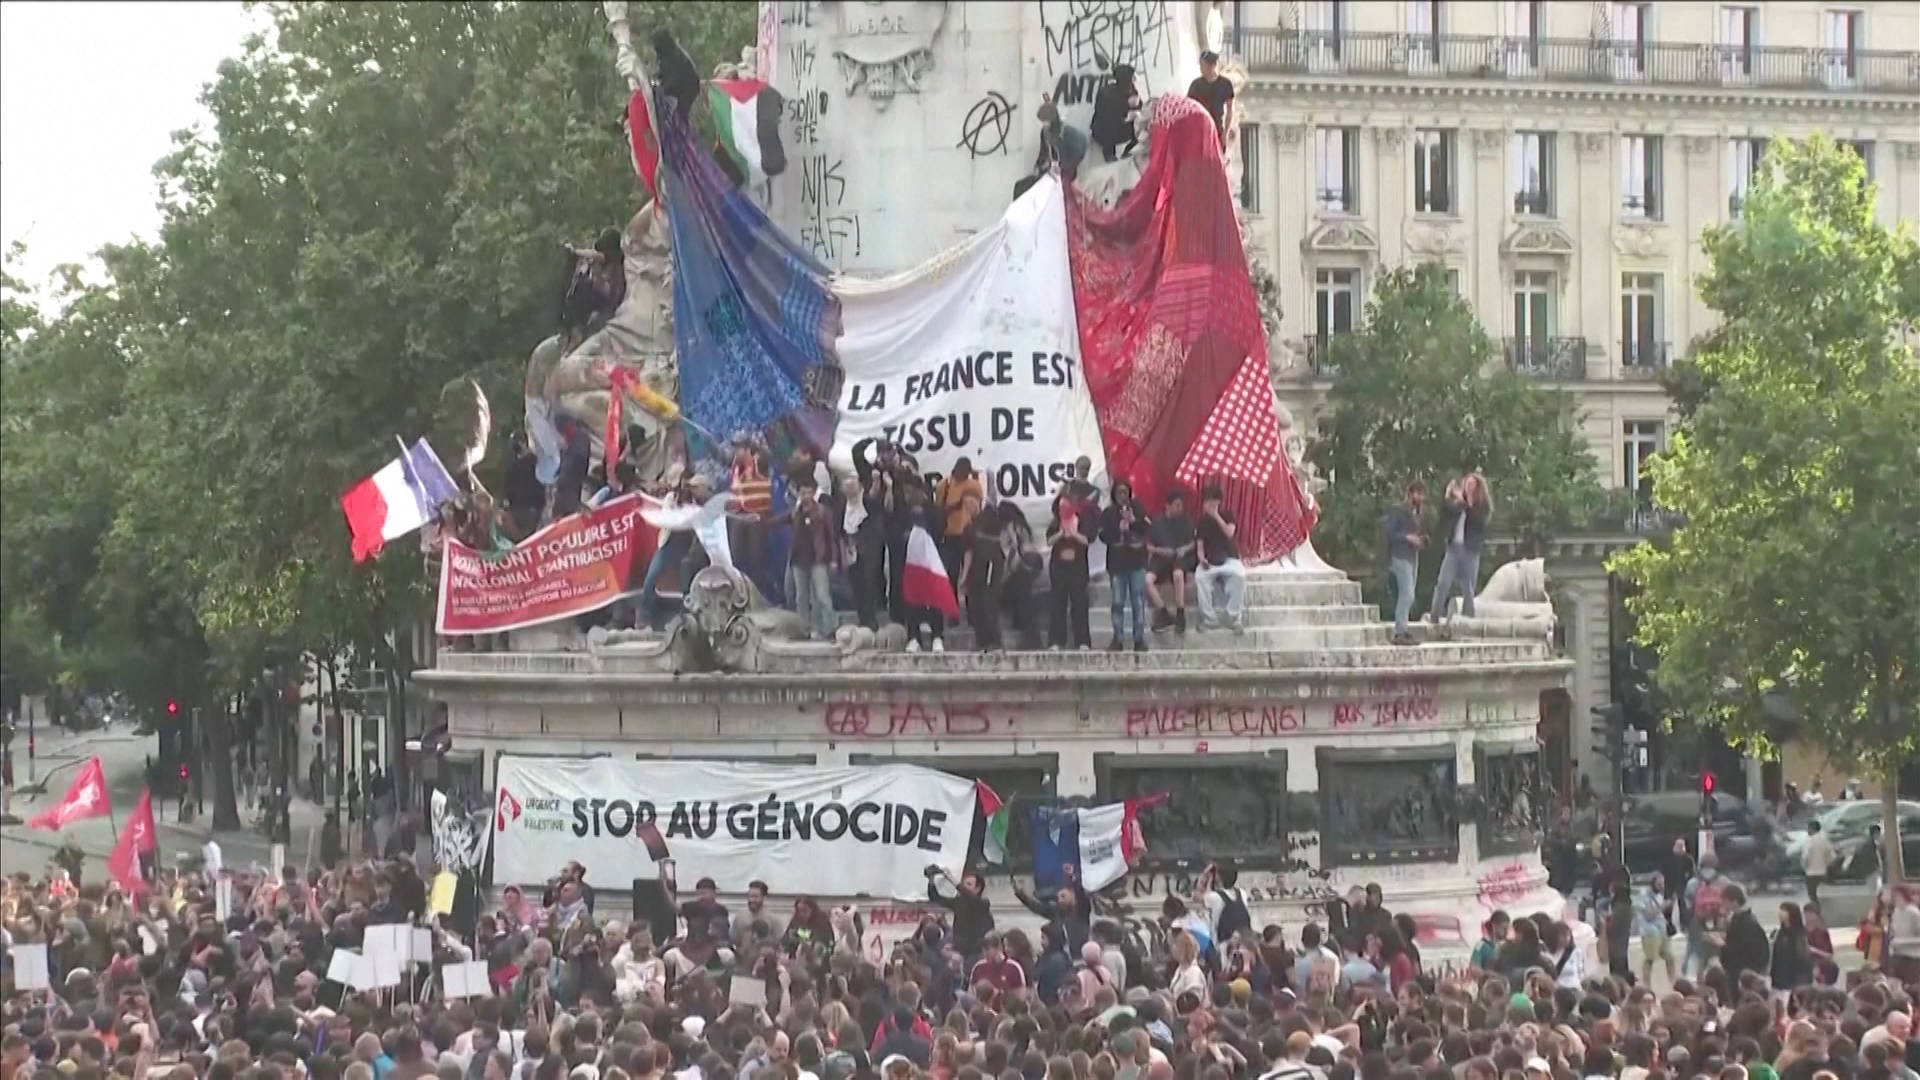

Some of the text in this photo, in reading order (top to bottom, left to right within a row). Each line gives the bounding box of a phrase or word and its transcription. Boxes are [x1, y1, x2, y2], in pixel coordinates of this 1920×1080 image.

[801, 154, 846, 207] NIK
[848, 350, 1076, 411] LA FRANCE EST
[991, 407, 1034, 441] DE
[610, 512, 636, 535] EST
[524, 797, 560, 811] URGENCE
[524, 818, 565, 832] PALESTINE
[572, 793, 947, 852] STOP AU GÉNOCIDE
